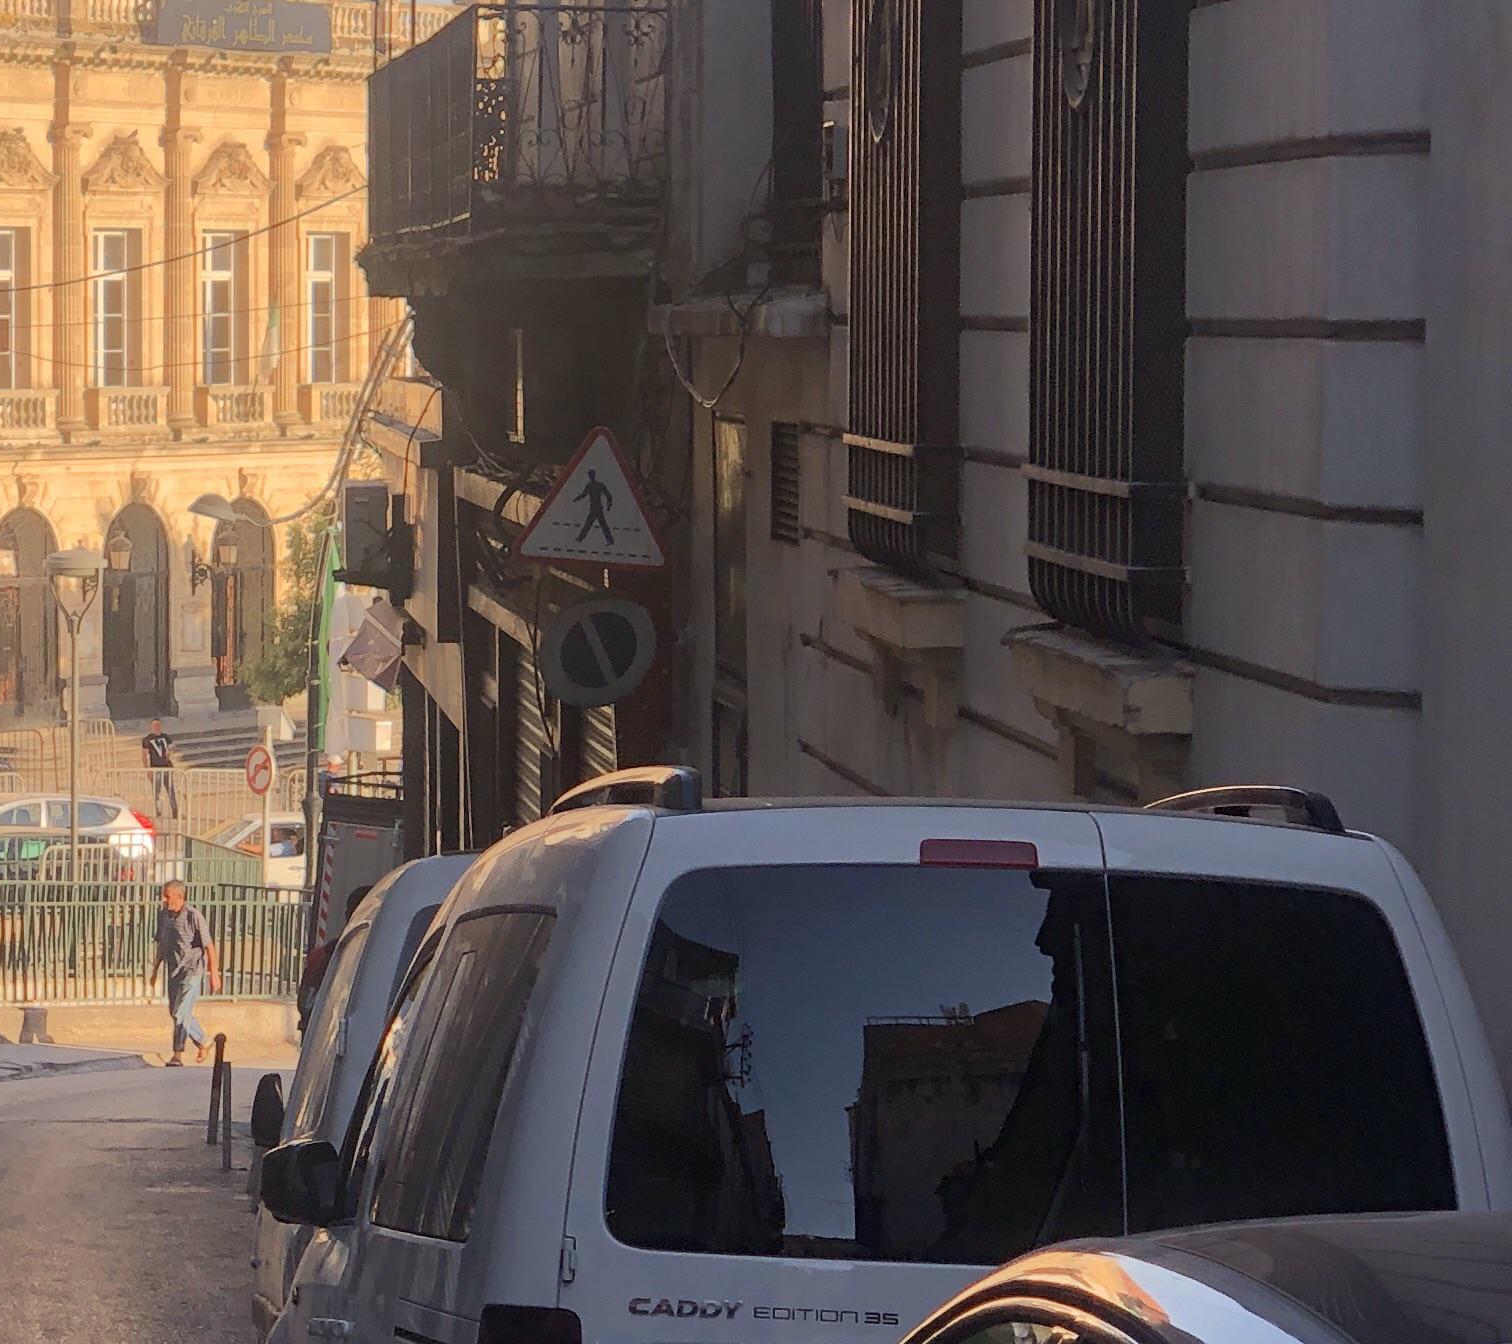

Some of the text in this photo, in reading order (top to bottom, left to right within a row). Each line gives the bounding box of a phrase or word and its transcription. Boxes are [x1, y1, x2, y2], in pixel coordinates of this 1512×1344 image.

[628, 1297, 900, 1326] CADDY EDITION 35
